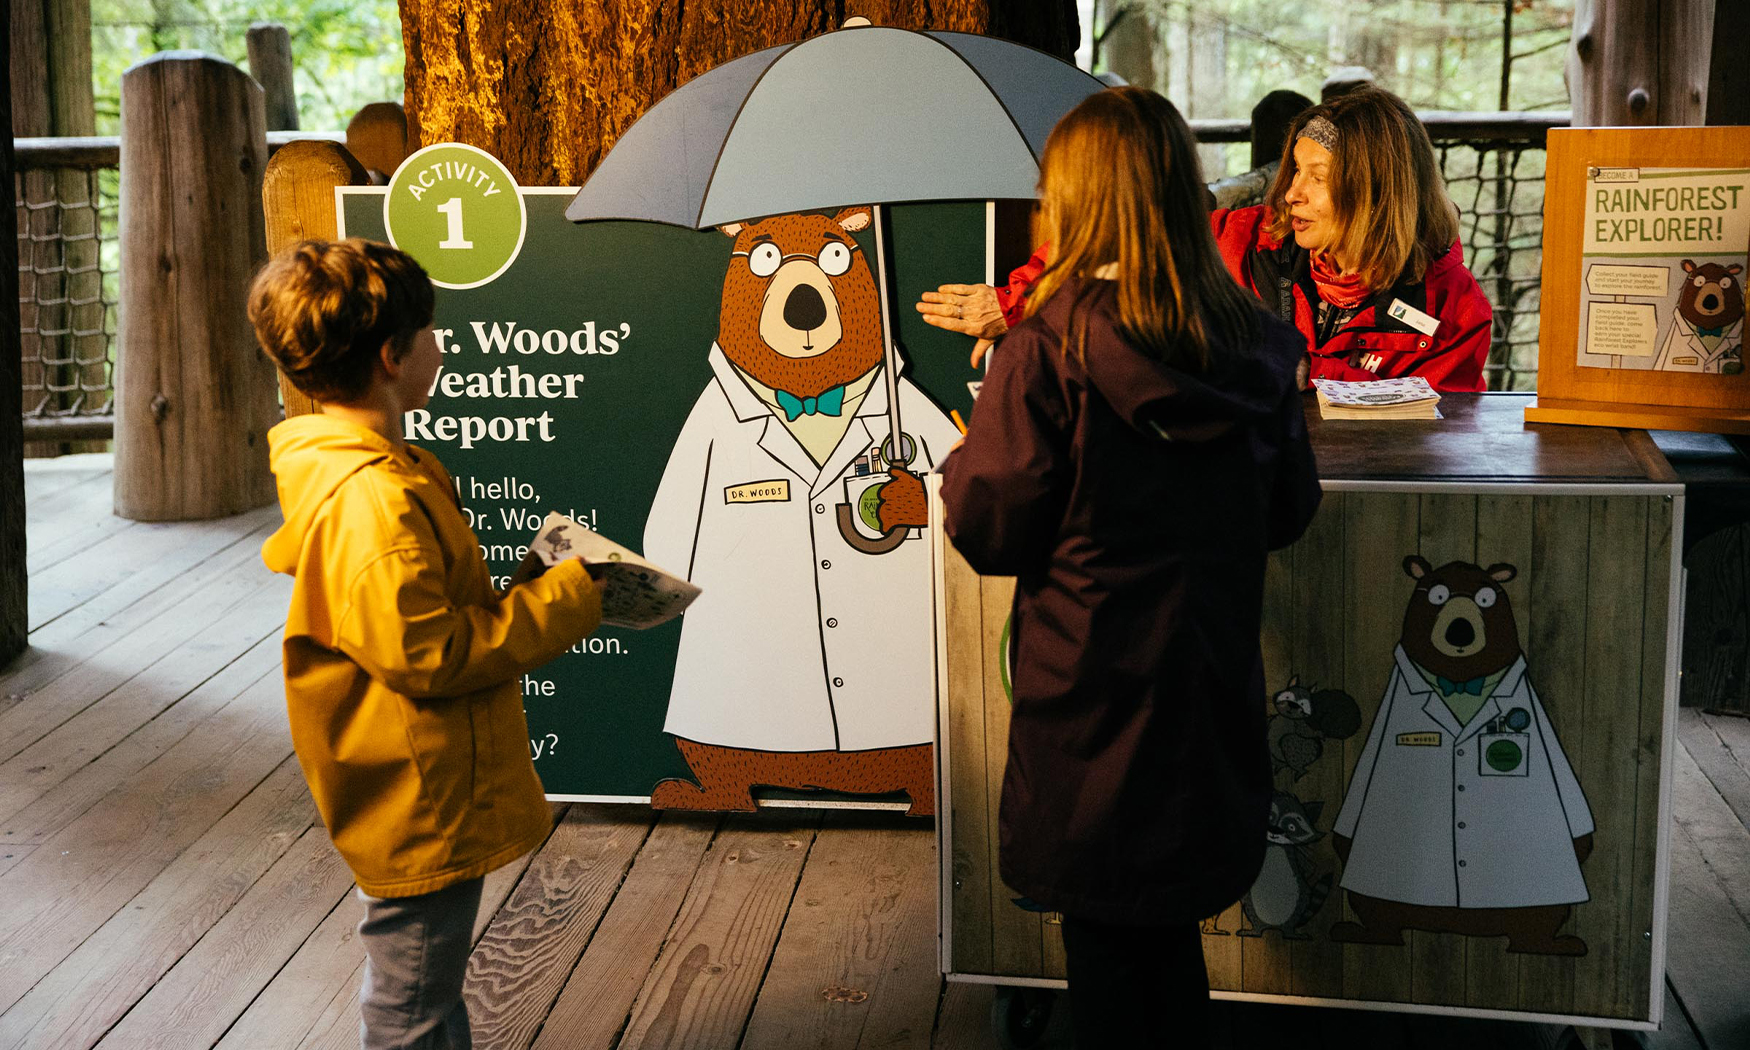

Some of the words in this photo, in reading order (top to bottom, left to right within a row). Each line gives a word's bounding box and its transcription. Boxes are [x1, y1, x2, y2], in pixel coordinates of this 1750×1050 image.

[408, 161, 501, 201] ACTIVITY
[1595, 185, 1744, 213] RAINFOREST
[437, 197, 474, 249] 1
[1595, 217, 1723, 242] EXPLORER!
[432, 328, 461, 354] r.
[470, 321, 631, 355] Woods’
[428, 364, 584, 398] eather
[403, 409, 556, 449] Report
[470, 476, 541, 503] hello,
[750, 487, 782, 497] WOODS
